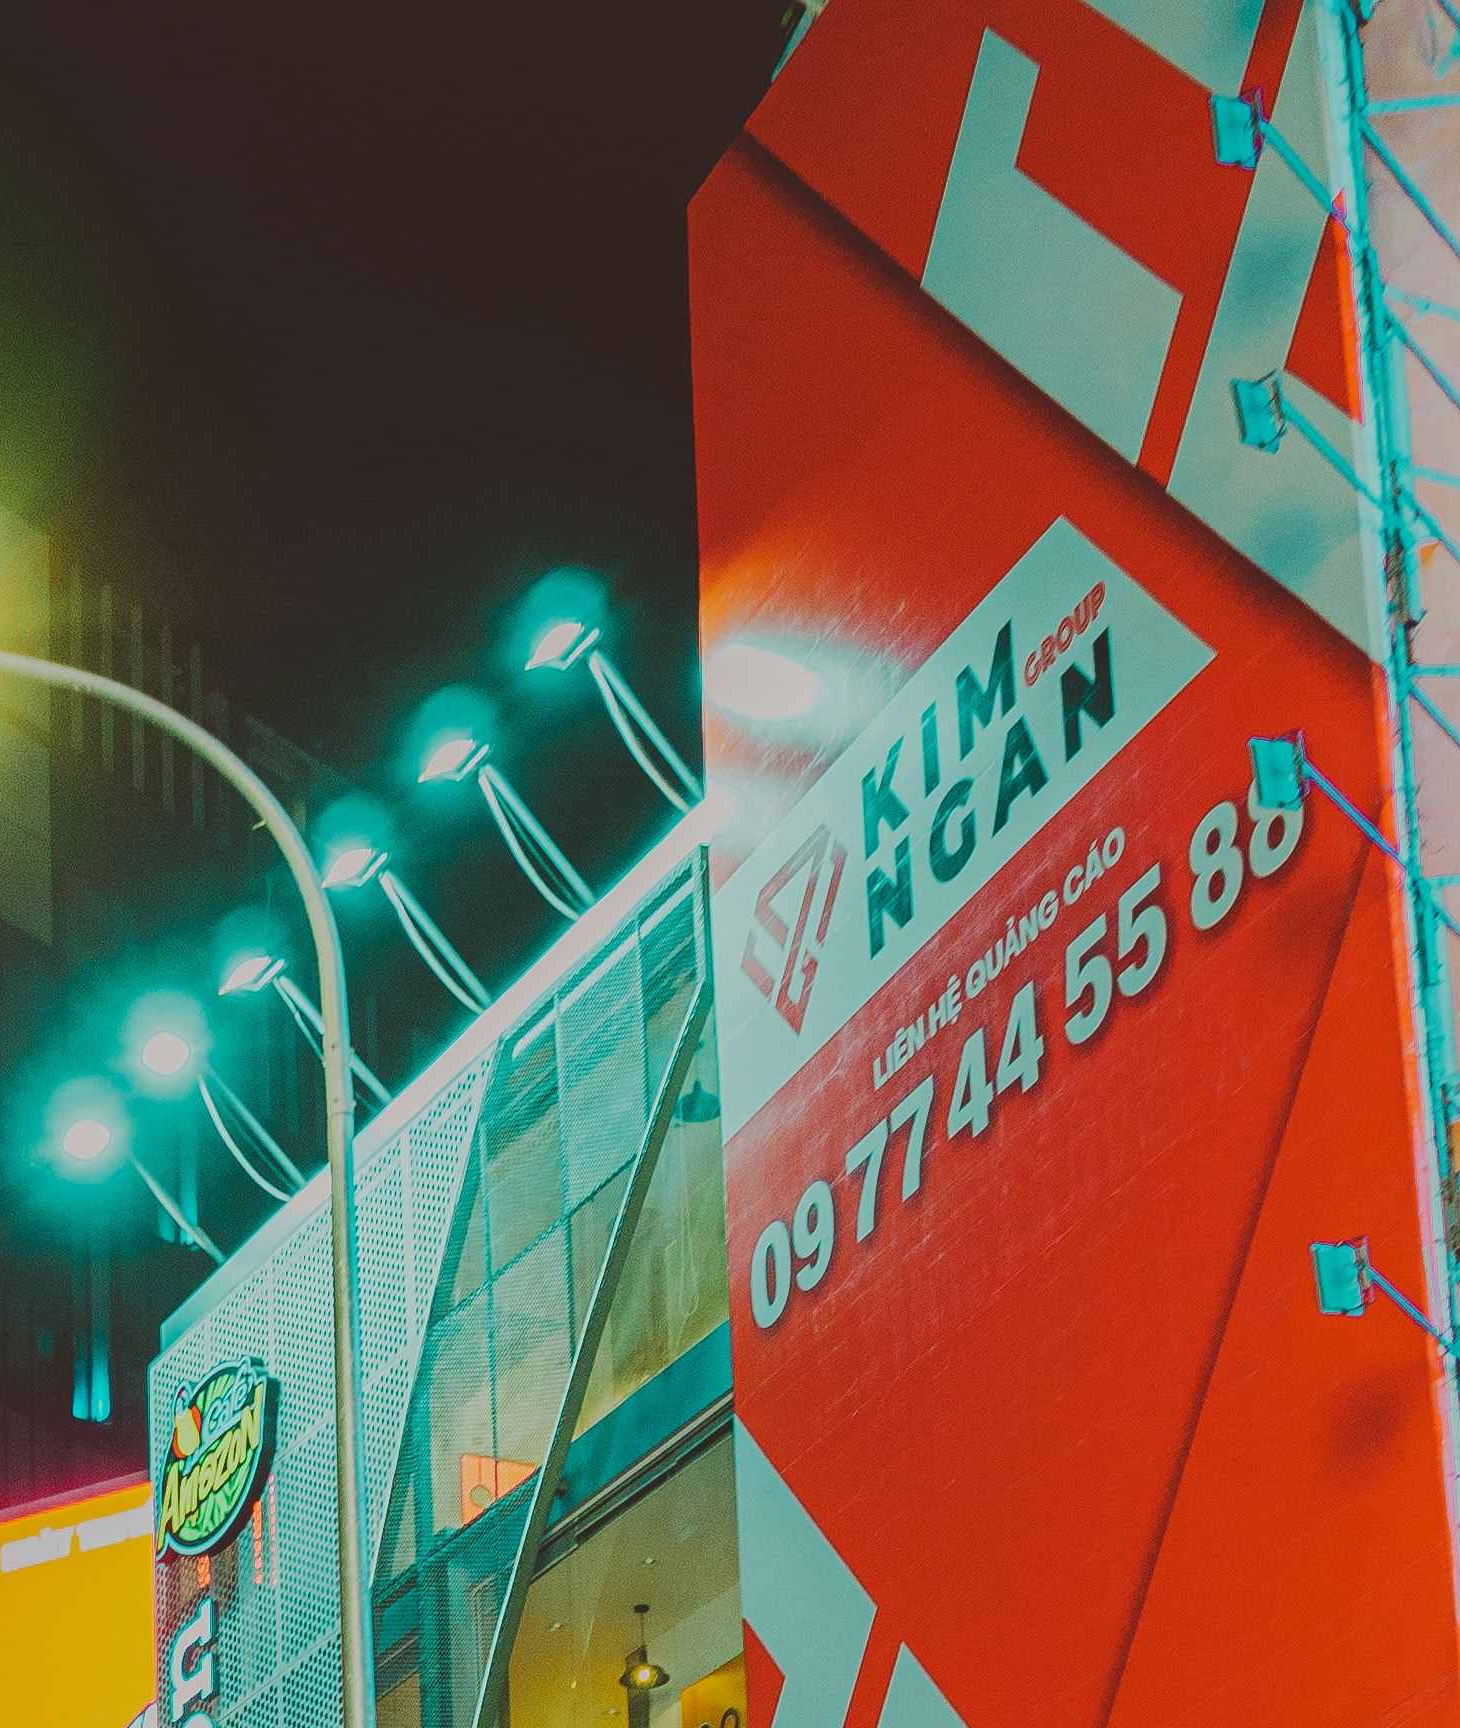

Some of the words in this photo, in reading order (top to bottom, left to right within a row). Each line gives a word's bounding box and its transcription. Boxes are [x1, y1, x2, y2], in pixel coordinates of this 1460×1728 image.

[861, 618, 1020, 862] KIM
[1022, 581, 1108, 688] GROUP
[864, 626, 1118, 962] NGAN
[750, 1180, 836, 1331] 09
[843, 1075, 936, 1246] 77
[946, 980, 1046, 1142] 44
[1063, 880, 1170, 1047] 55
[872, 1013, 927, 1091] LIÊN
[927, 973, 963, 1040] HỆ
[964, 888, 1059, 1001] QUẢNG
[1062, 825, 1126, 906] CÁO
